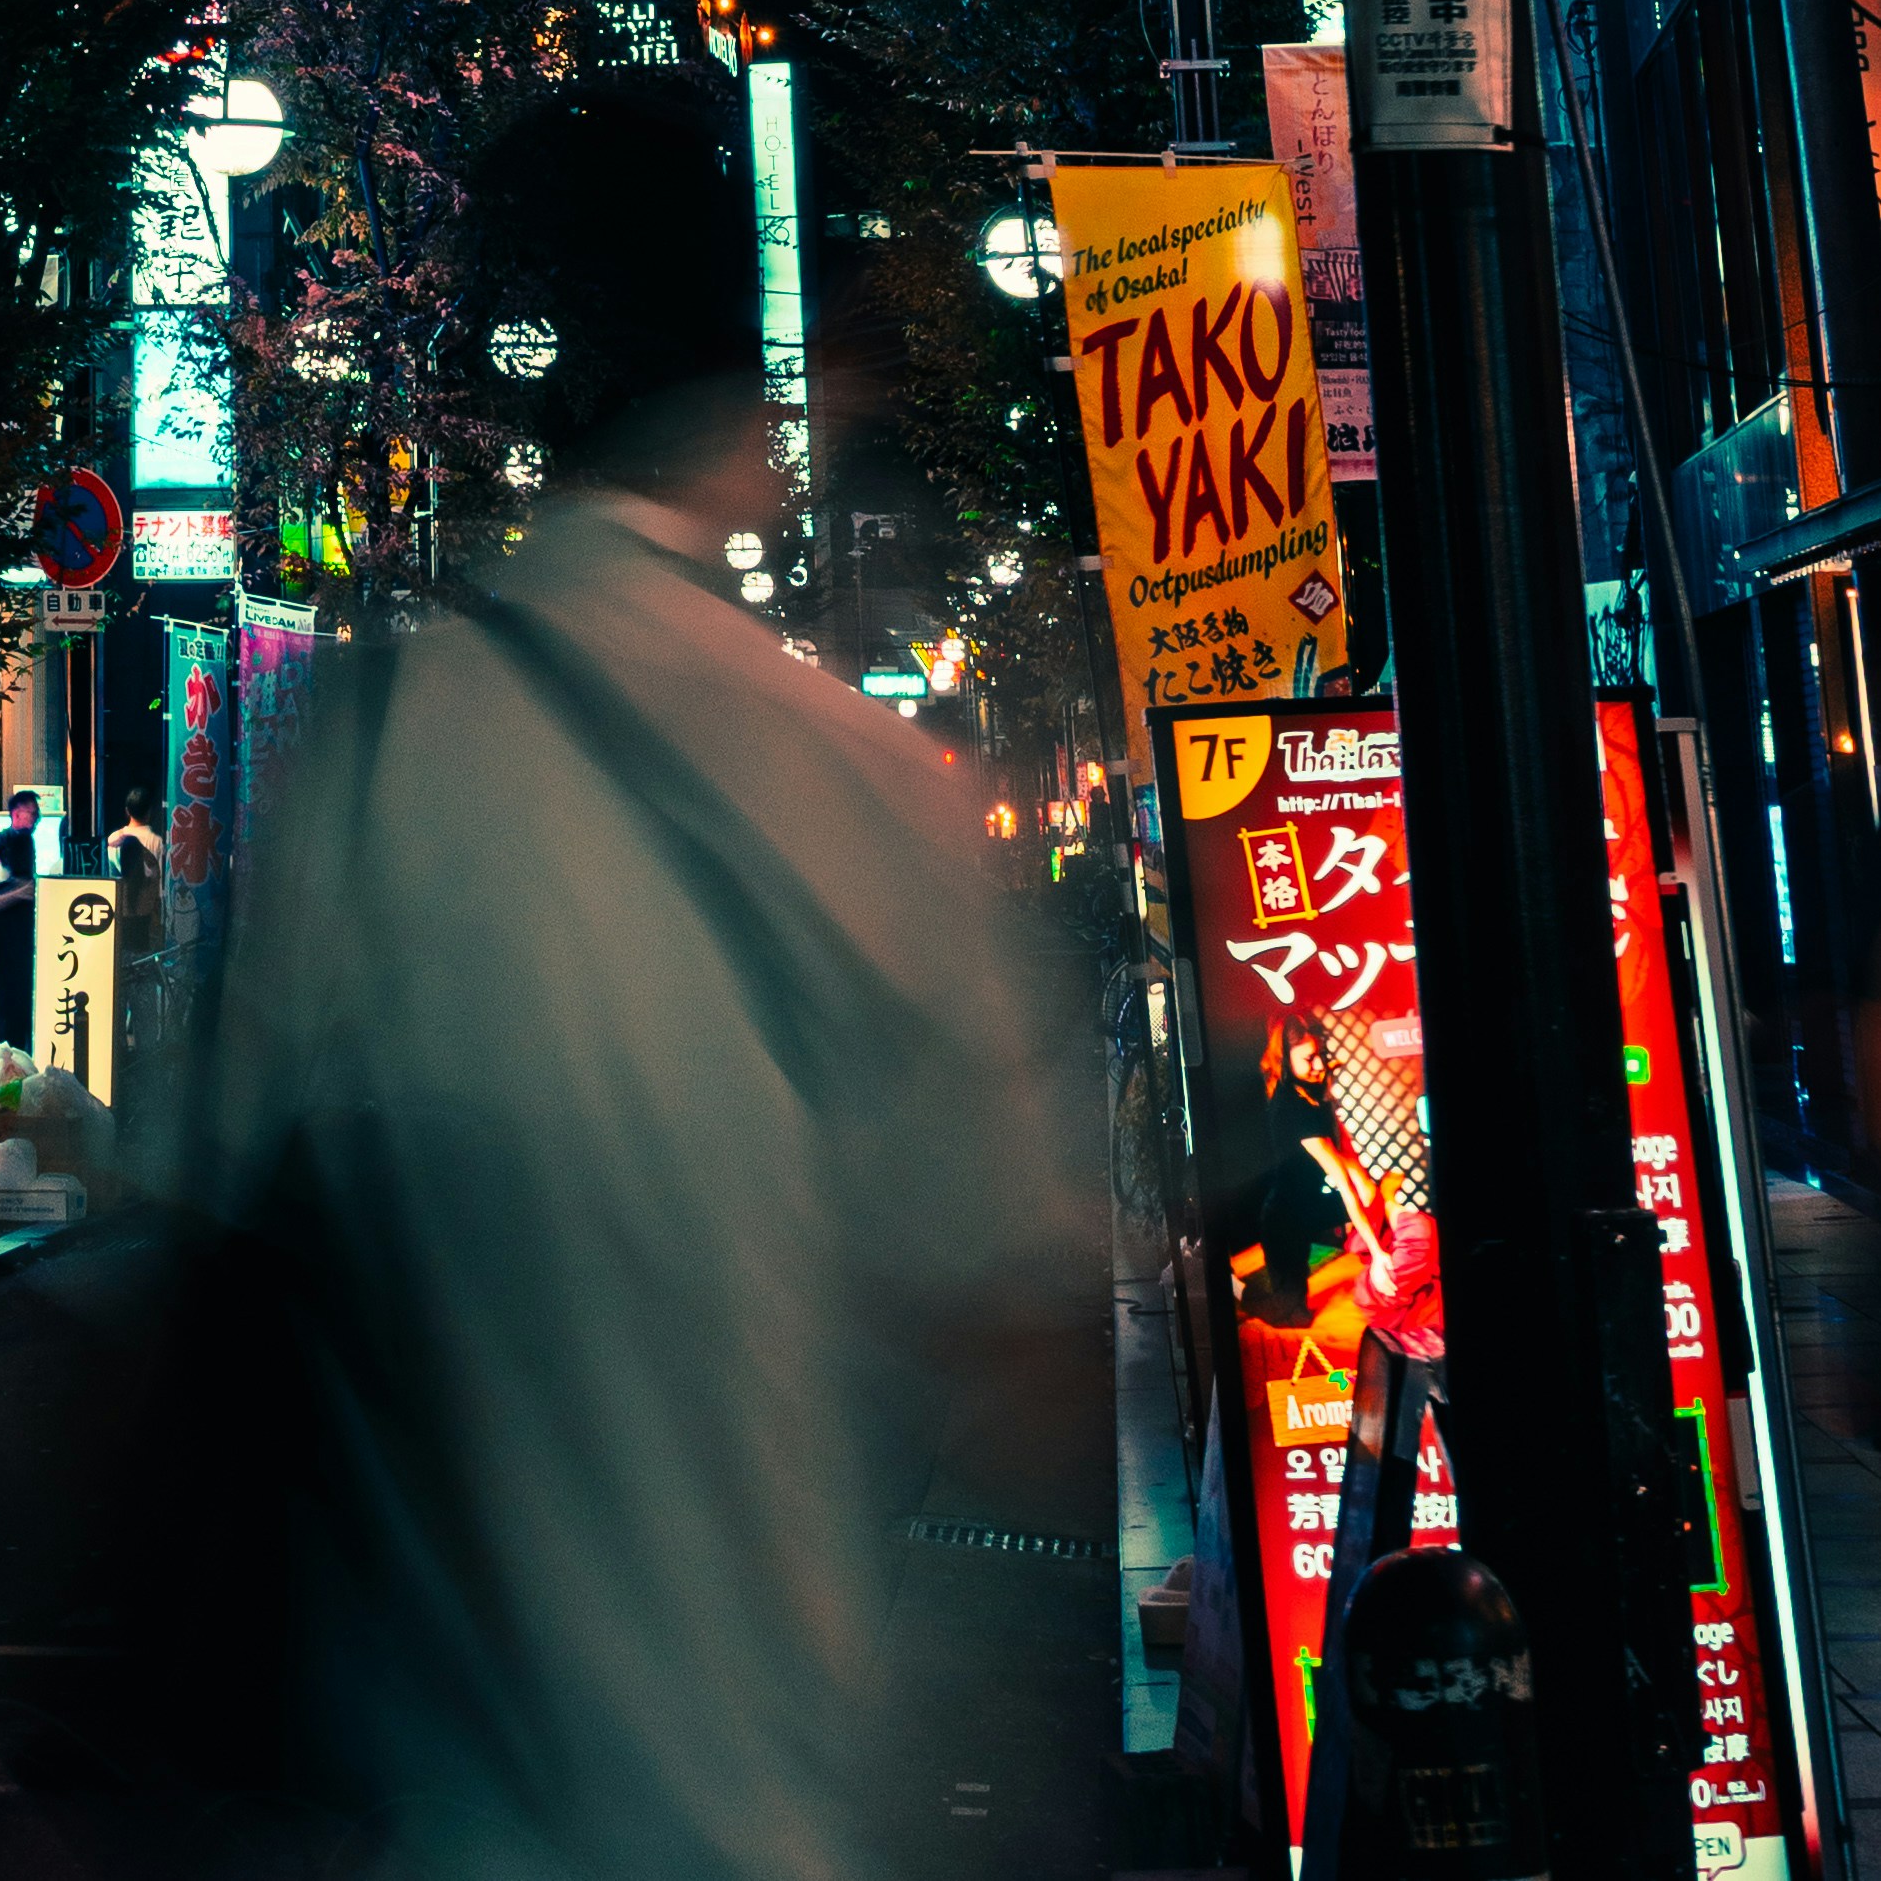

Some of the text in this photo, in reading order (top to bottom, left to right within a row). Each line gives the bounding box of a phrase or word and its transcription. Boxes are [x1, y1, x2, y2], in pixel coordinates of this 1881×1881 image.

[764, 115, 782, 211] HOTEL
[1072, 198, 1267, 278] The local specialty
[1084, 256, 1188, 315] of Osaka!
[1081, 278, 1294, 449] TAKO
[1135, 397, 1307, 565] YAKI
[134, 515, 233, 540] テナント募集
[46, 593, 103, 613] 自動車
[1142, 639, 1283, 706] たこ焼き
[1189, 733, 1247, 783] 7F
[1255, 838, 1300, 911] 本格
[73, 904, 110, 927] 2F
